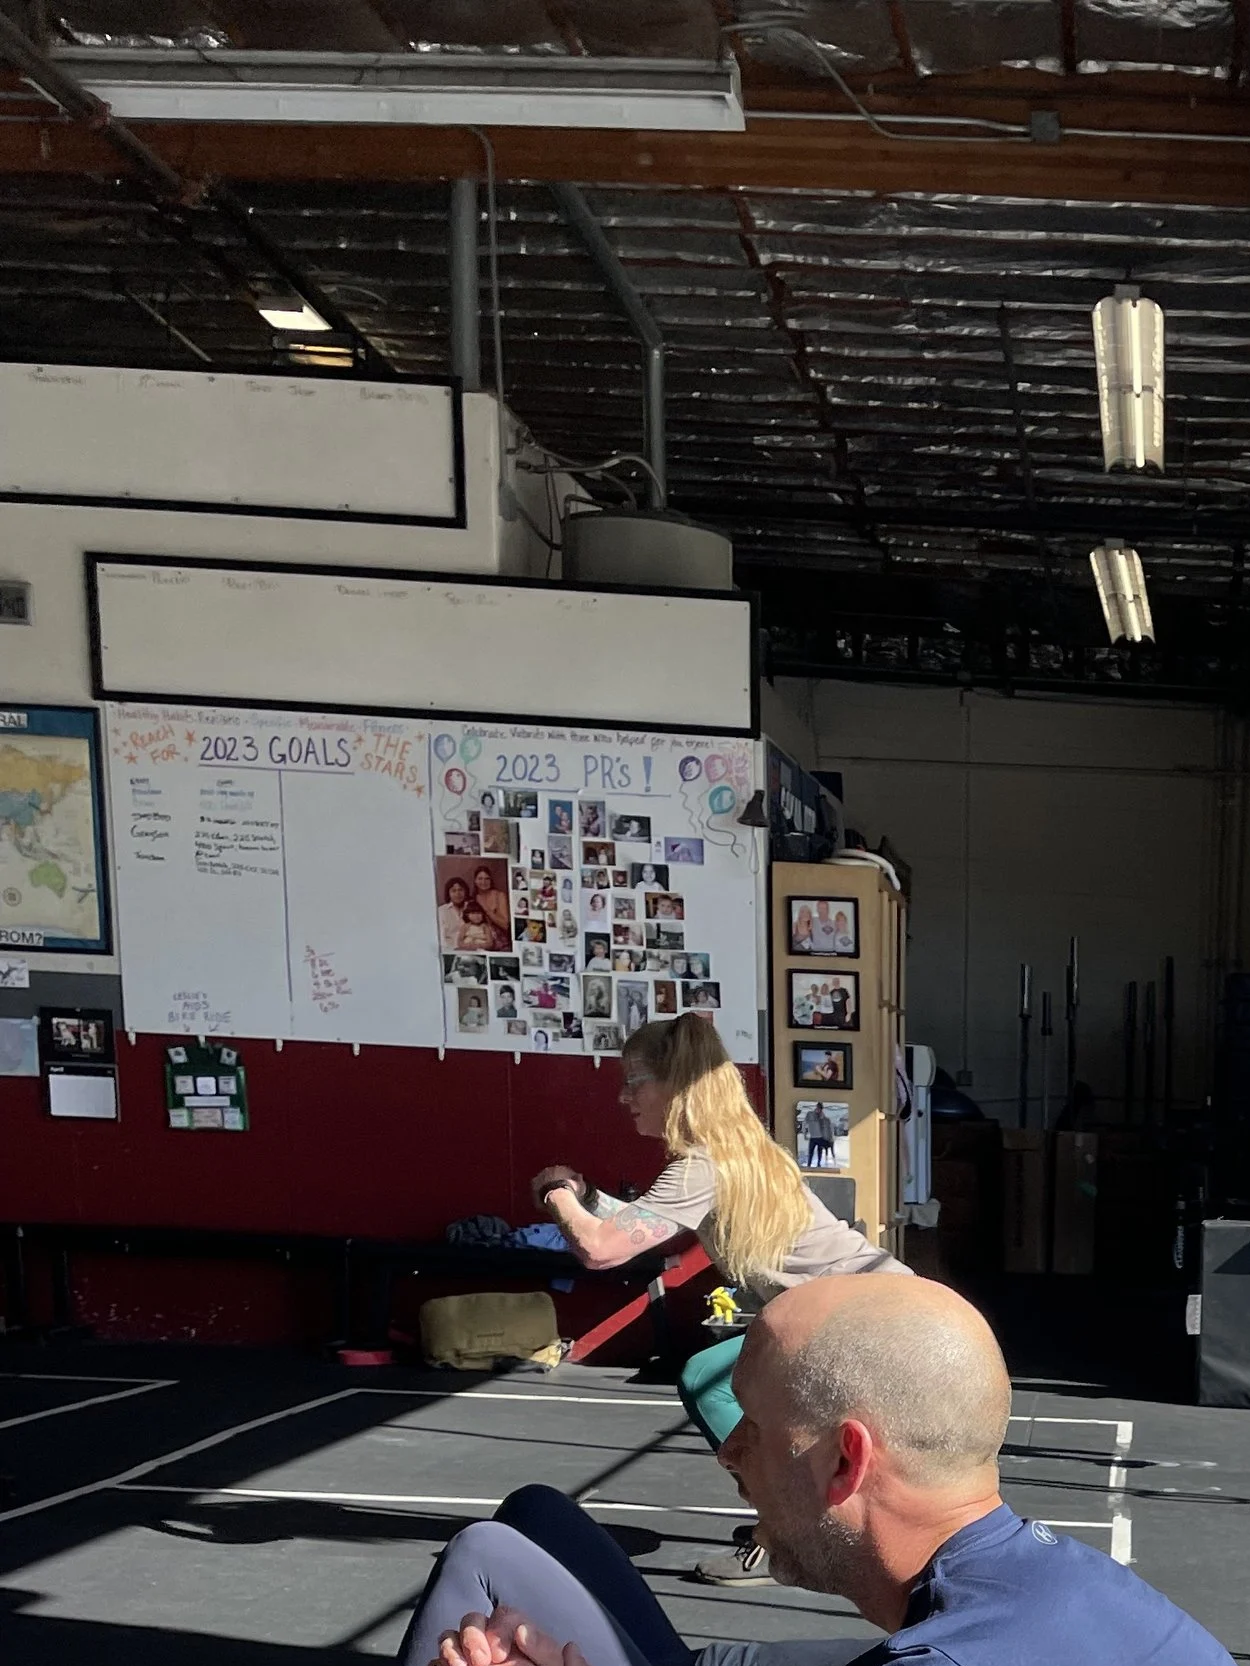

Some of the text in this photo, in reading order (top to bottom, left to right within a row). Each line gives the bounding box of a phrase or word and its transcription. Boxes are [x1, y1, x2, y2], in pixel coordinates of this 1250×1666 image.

[129, 724, 175, 748] REACH
[373, 732, 413, 761] THE
[150, 743, 180, 765] FOR
[200, 735, 350, 767] 2023 GOALS
[360, 752, 418, 784] STARS
[496, 753, 561, 783] 2023
[0, 930, 43, 944] ROM?
